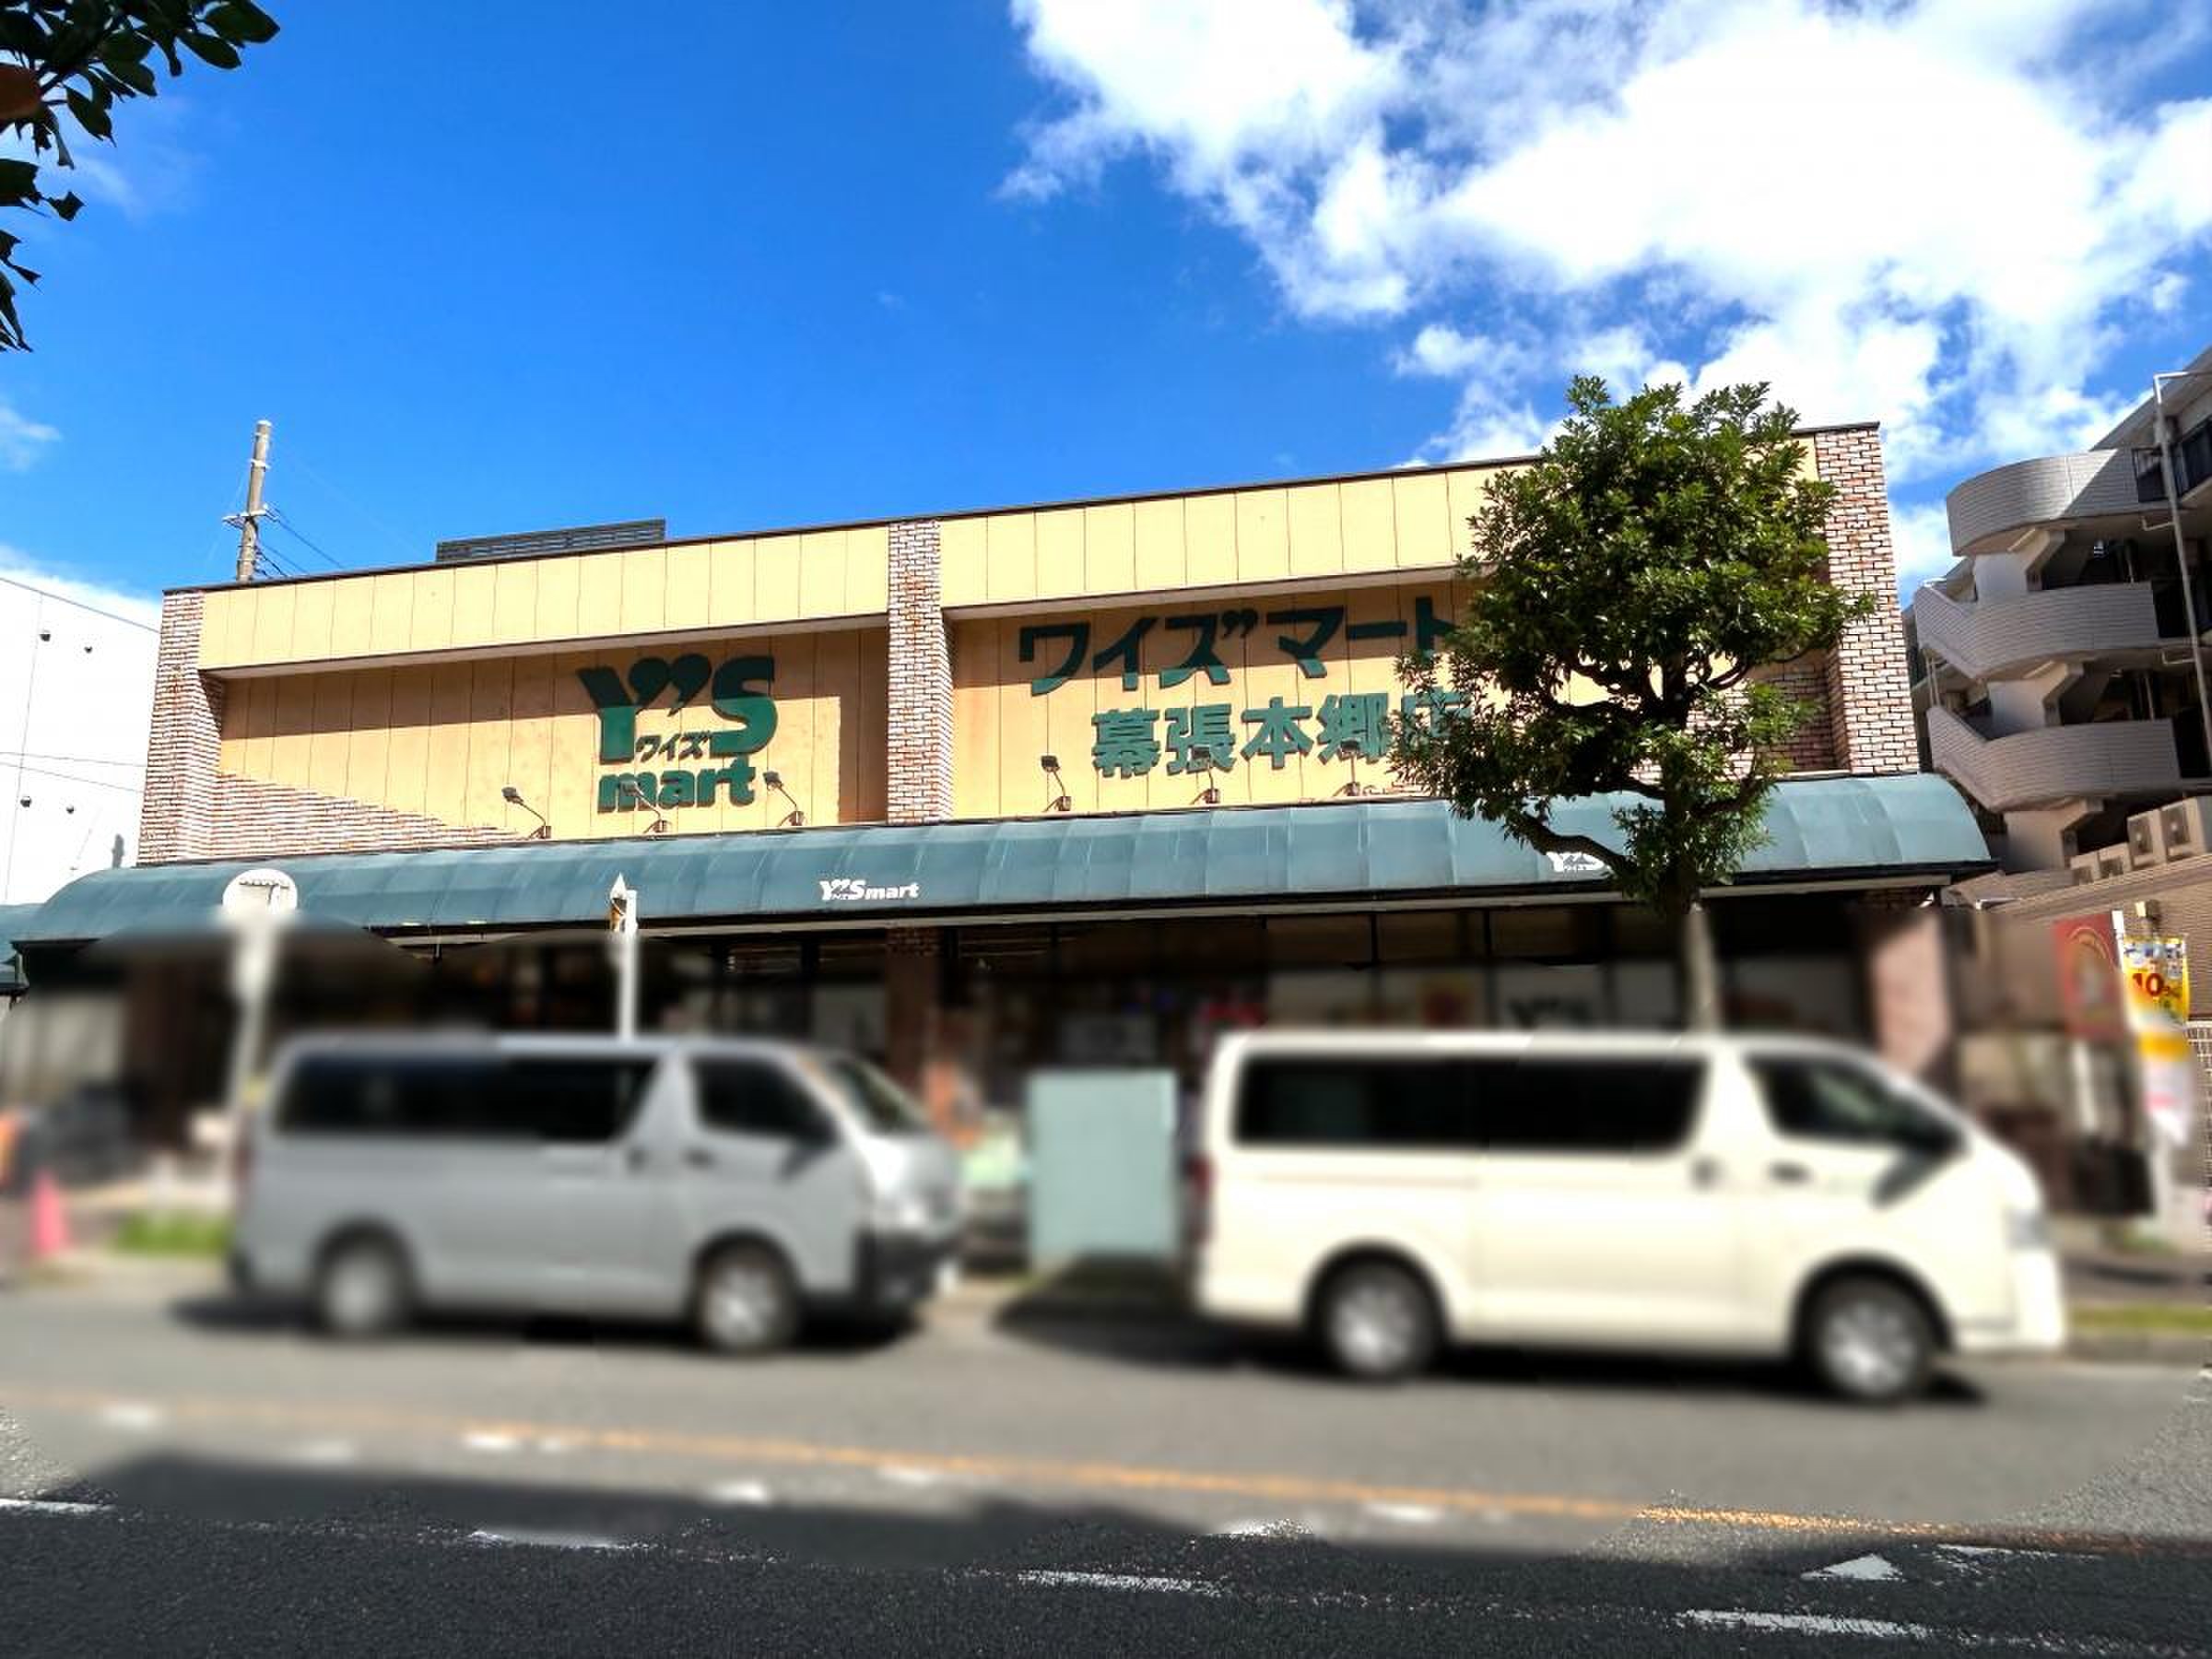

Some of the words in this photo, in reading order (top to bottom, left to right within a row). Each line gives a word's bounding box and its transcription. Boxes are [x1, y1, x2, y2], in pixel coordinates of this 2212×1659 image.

[635, 730, 709, 763] ワイズ
[597, 759, 756, 814] mart
